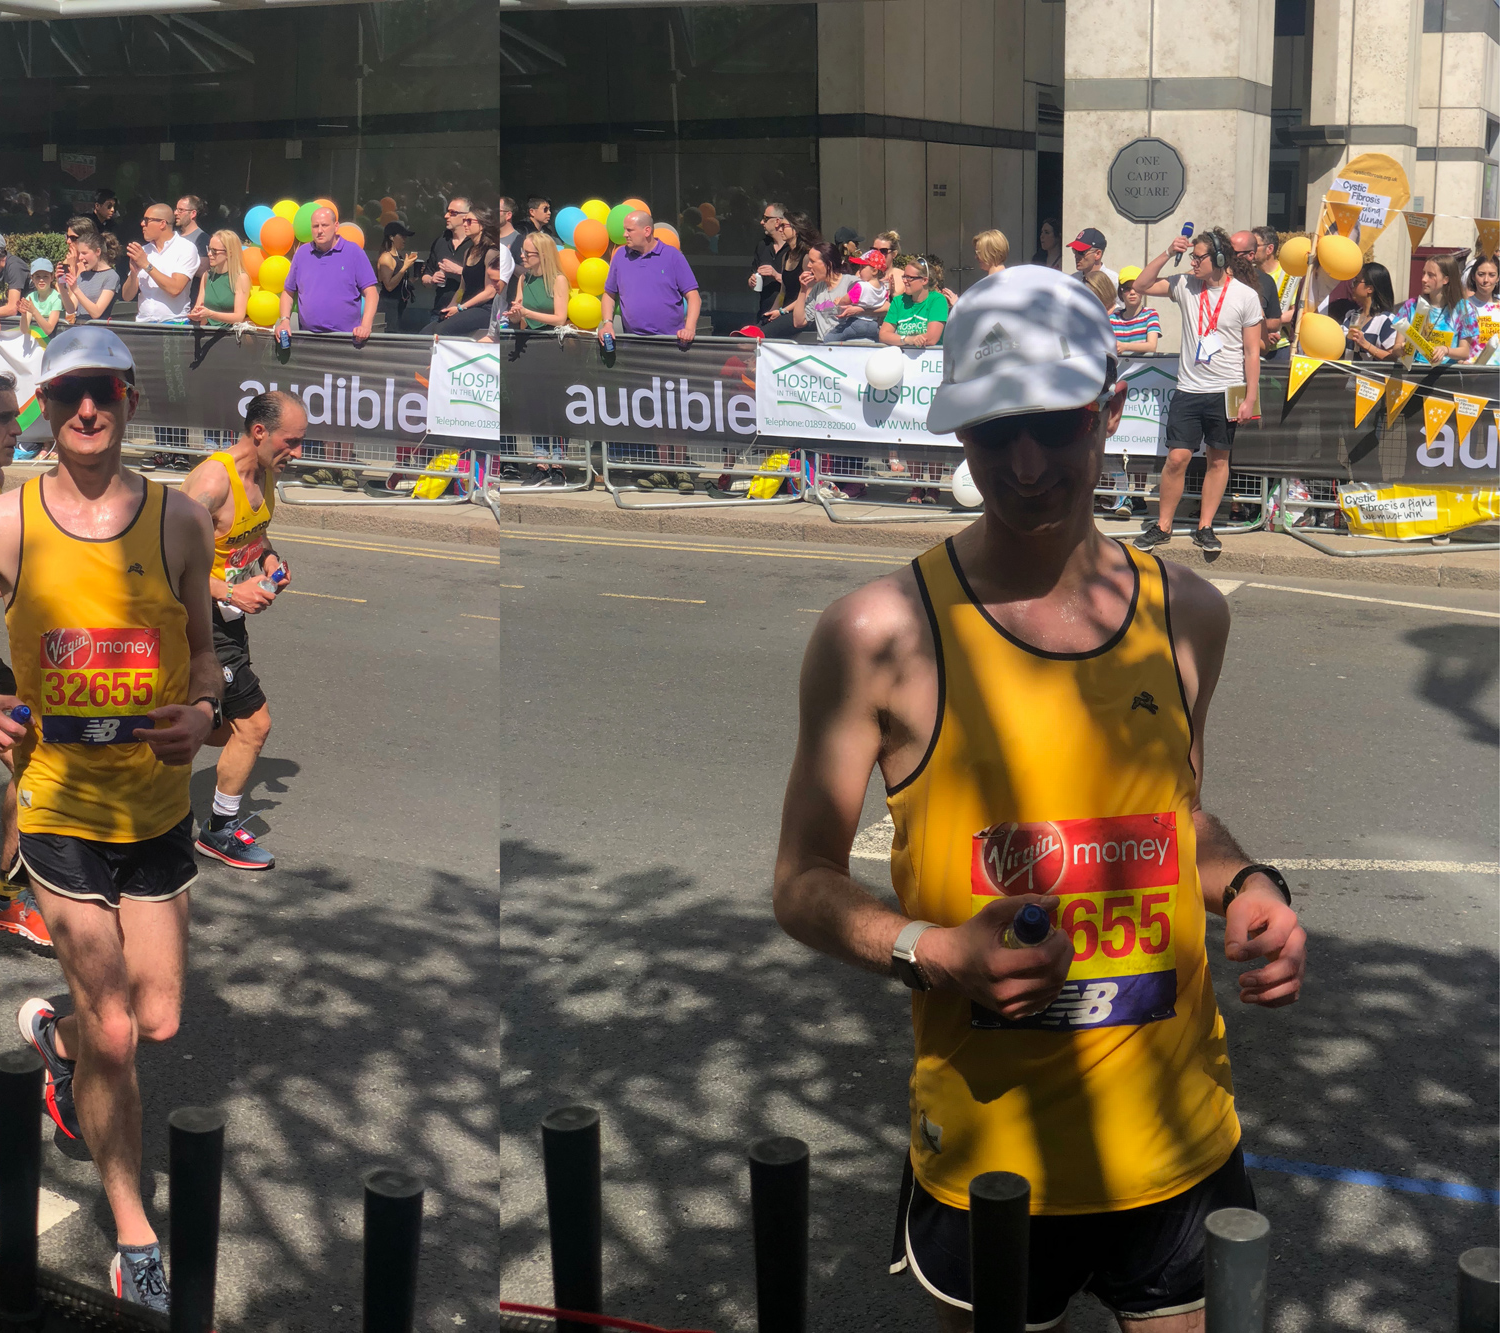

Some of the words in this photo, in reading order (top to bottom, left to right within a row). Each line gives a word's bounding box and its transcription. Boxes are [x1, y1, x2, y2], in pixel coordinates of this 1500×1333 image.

[1135, 156, 1160, 166] ONE
[1127, 171, 1168, 181] CABOT
[1124, 186, 1170, 199] SQUARE
[1342, 180, 1367, 193] Cystic
[1351, 192, 1381, 205] Fibrosis
[921, 360, 942, 374] PLE
[451, 372, 499, 389] HOSPI
[777, 374, 841, 391] HOSPICE
[472, 390, 500, 403] WEA
[785, 390, 798, 398] THE
[798, 391, 842, 404] WEALD
[1127, 387, 1176, 402] OSPIC
[238, 373, 429, 434] adible
[565, 376, 756, 435] audible
[1138, 404, 1169, 417] WEA
[435, 416, 477, 428] Telephone:
[477, 419, 500, 429] 01892
[765, 417, 804, 429] Telephone:
[805, 419, 828, 428] 01892
[828, 421, 856, 431] 820500
[875, 418, 929, 432] www.ho
[1132, 436, 1161, 444] CHARITY
[1345, 493, 1376, 506] Cystic
[1407, 499, 1435, 512] fight
[1377, 510, 1403, 521] must
[1404, 508, 1424, 519] win
[49, 628, 90, 666] Virgin
[96, 641, 155, 658] money
[45, 672, 153, 708] 32655
[988, 823, 1060, 889] Virgin
[1073, 837, 1170, 866] money
[1054, 893, 1171, 962] 655
